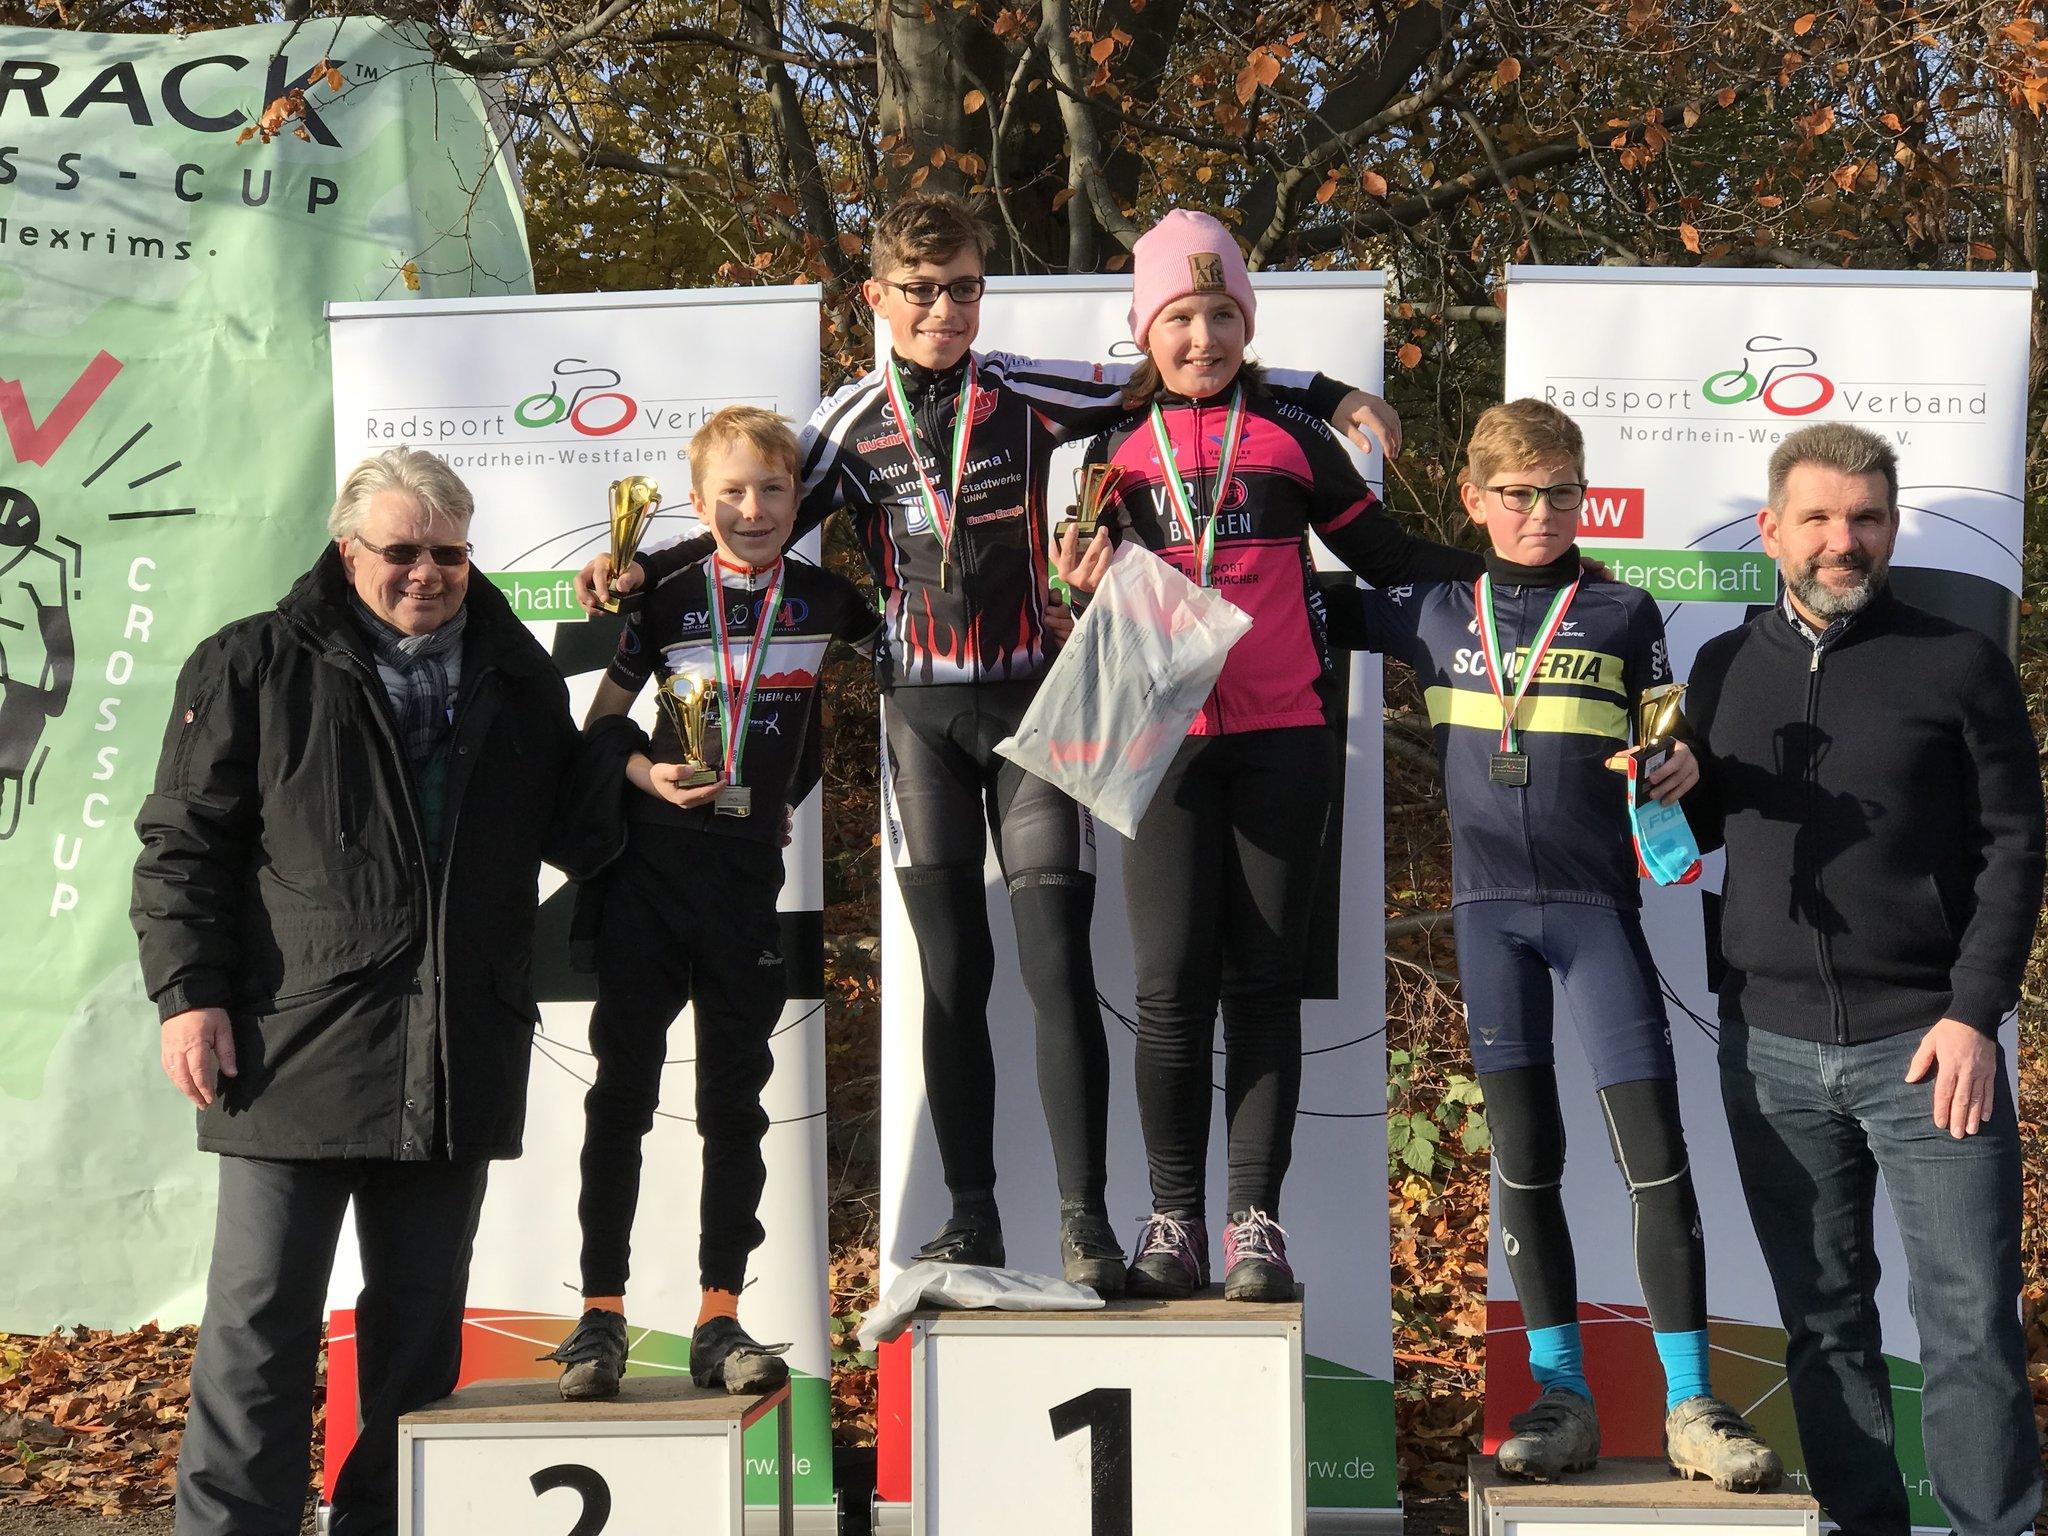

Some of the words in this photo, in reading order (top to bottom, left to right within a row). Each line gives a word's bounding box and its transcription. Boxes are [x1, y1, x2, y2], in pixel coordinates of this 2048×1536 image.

[0, 54, 346, 148] RACK
[1545, 385, 1692, 414] Radsport
[1843, 391, 1987, 415] Verband
[367, 415, 504, 441] Radsport
[881, 420, 897, 428] TOY
[437, 446, 667, 468] Nordrhein-Westfalen
[869, 462, 908, 484] Aktiv
[912, 456, 936, 472] für
[894, 473, 942, 494] unser
[960, 472, 1023, 494] Stadtwerke
[963, 492, 988, 504] UNNA
[1150, 481, 1198, 521] VR
[966, 512, 996, 526] Unsere
[995, 504, 1025, 520] Energie
[1210, 574, 1260, 586] MACHER
[1605, 559, 1762, 592] terschaft
[500, 580, 574, 610] chaft
[1049, 1388, 1133, 1536] 1
